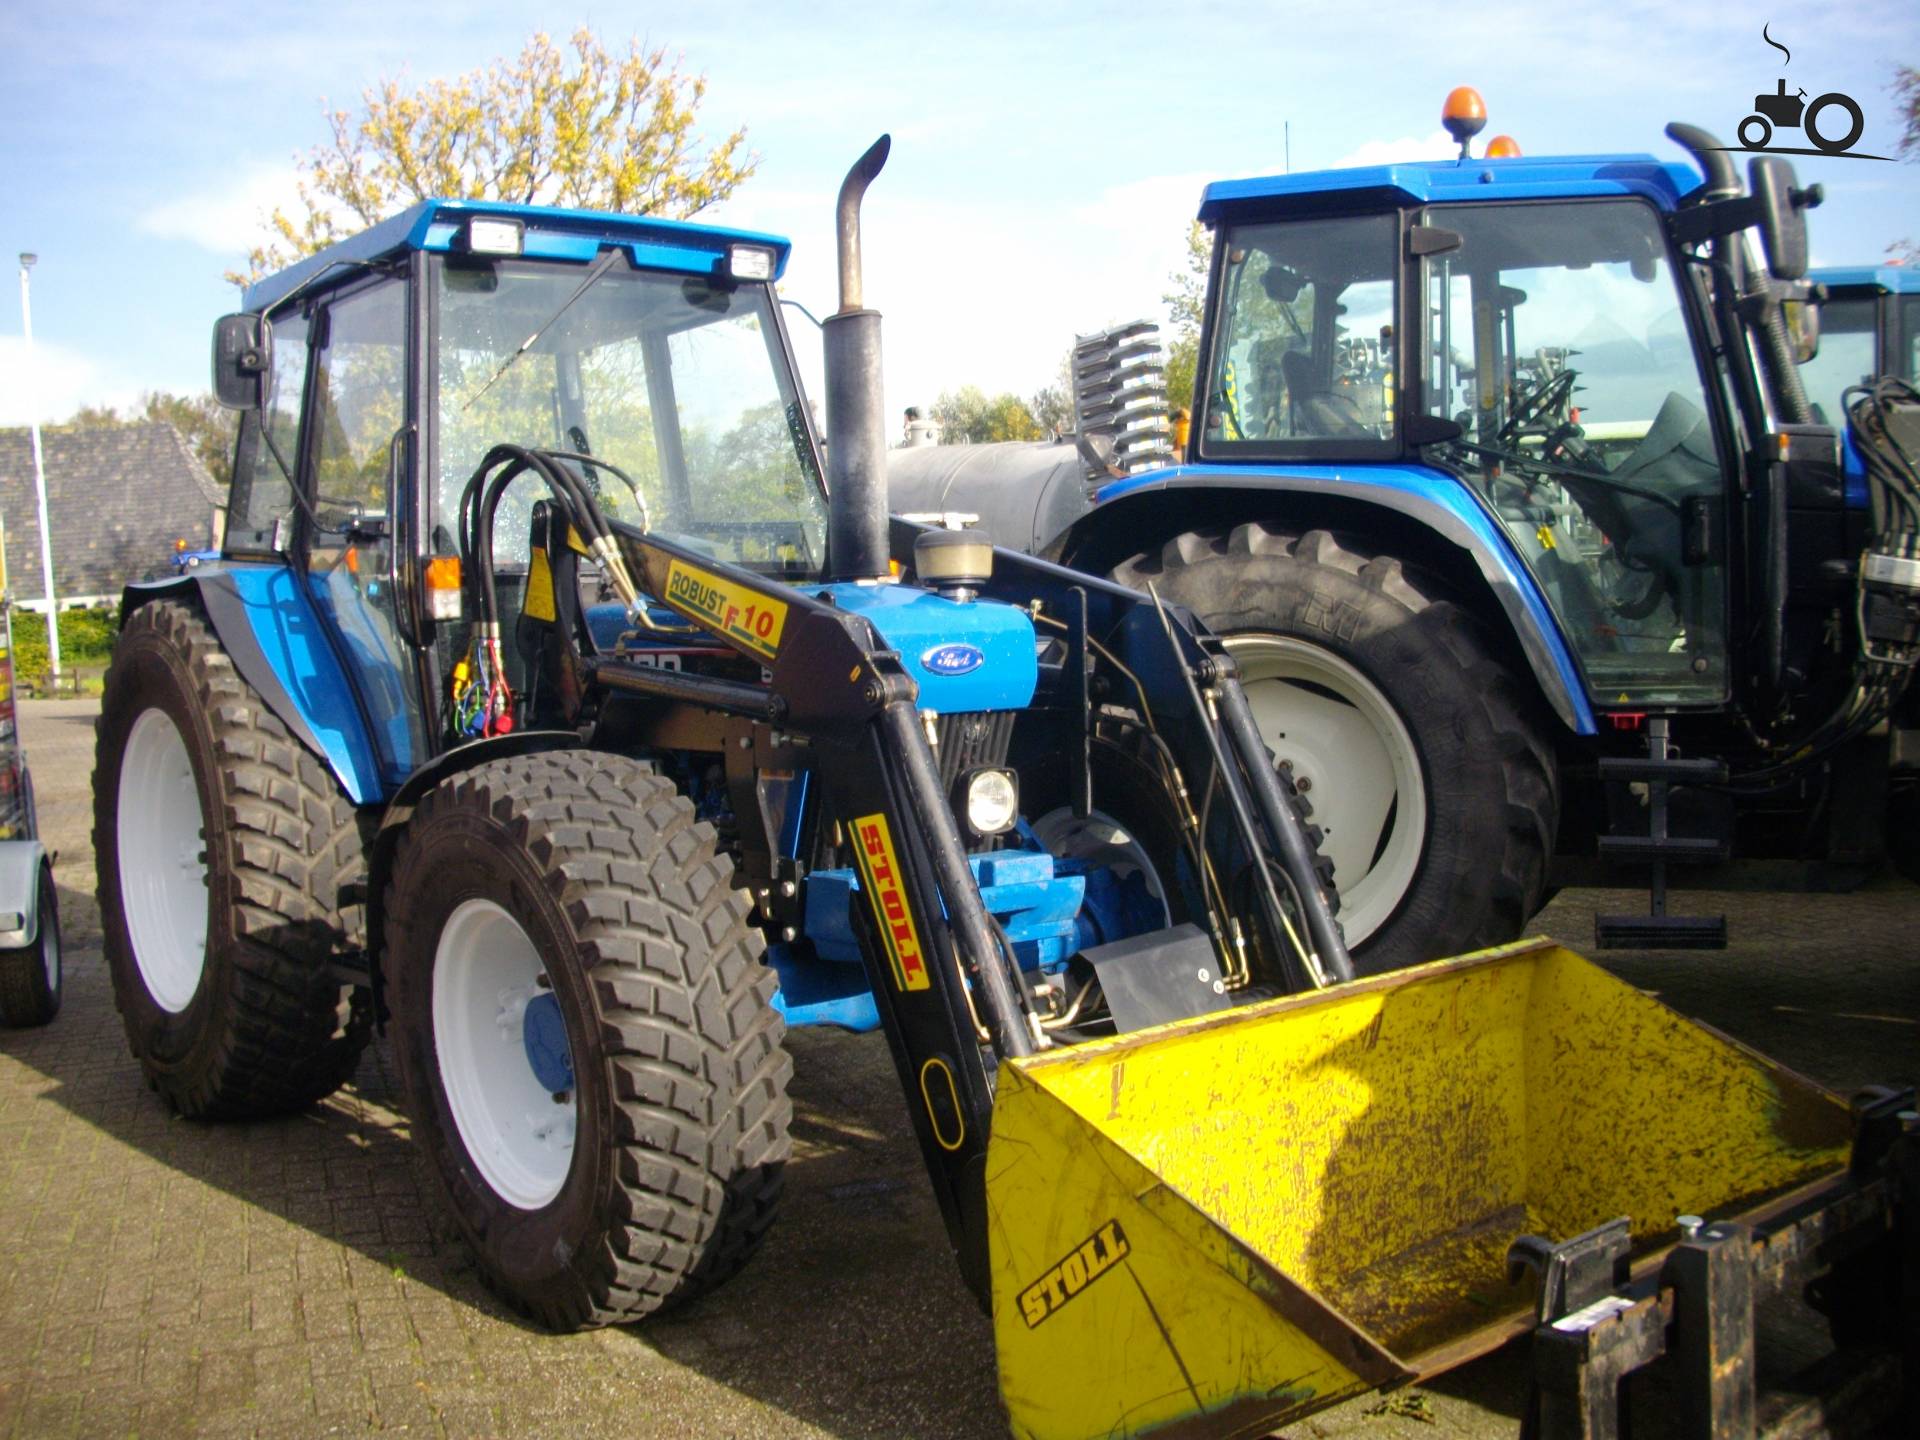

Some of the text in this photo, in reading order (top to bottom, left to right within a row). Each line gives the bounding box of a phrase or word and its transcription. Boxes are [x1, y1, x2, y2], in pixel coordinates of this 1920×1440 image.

[670, 570, 727, 615] ROBUST
[860, 823, 923, 982] STOLL
[1018, 1221, 1129, 1328] STOLL
